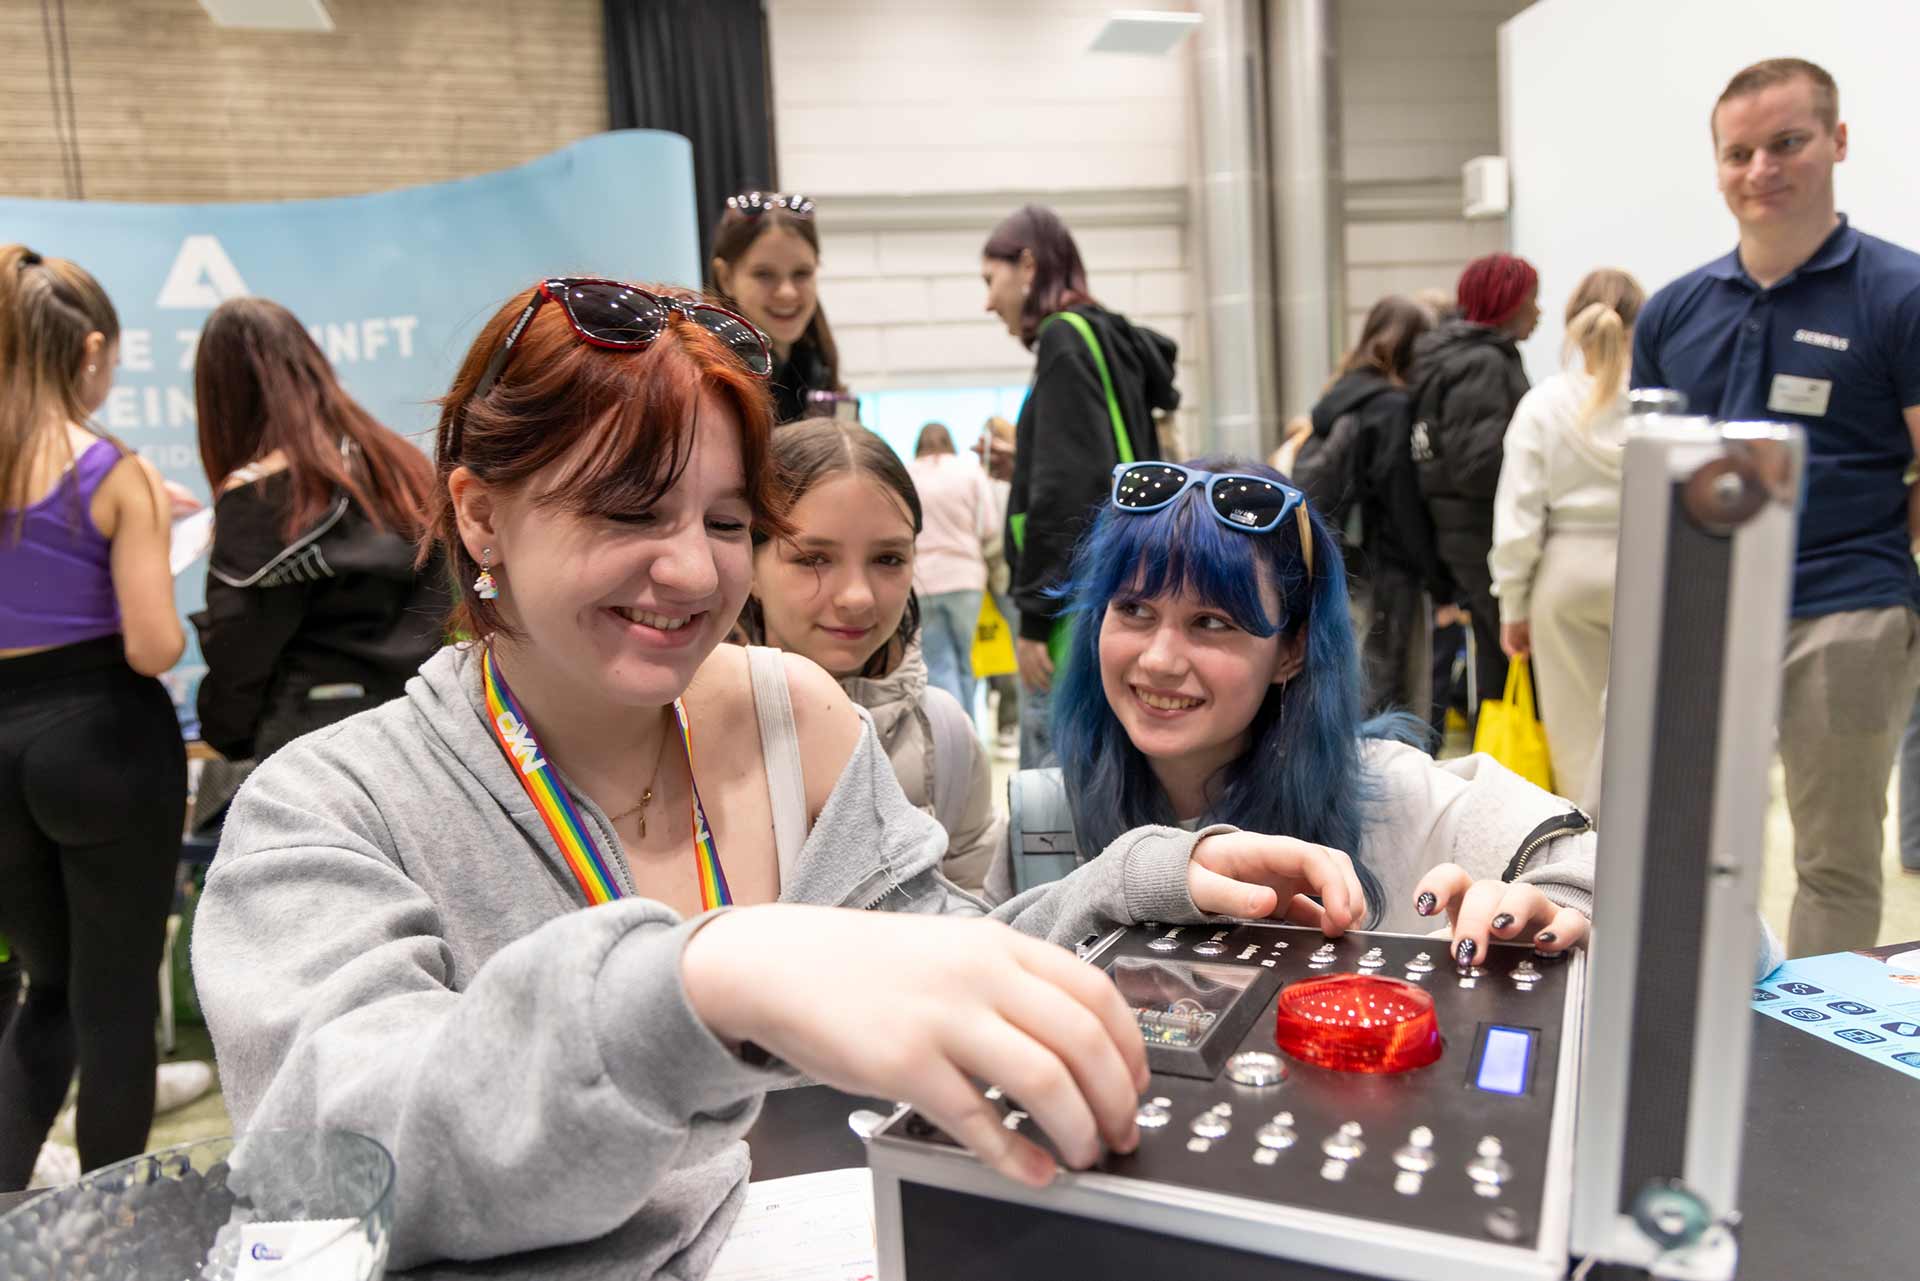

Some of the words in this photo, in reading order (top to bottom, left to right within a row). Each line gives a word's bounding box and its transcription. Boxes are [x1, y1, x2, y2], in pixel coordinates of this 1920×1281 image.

[174, 315, 417, 370] ZNFT
[108, 386, 196, 427] EIN
[496, 711, 547, 775] NXP
